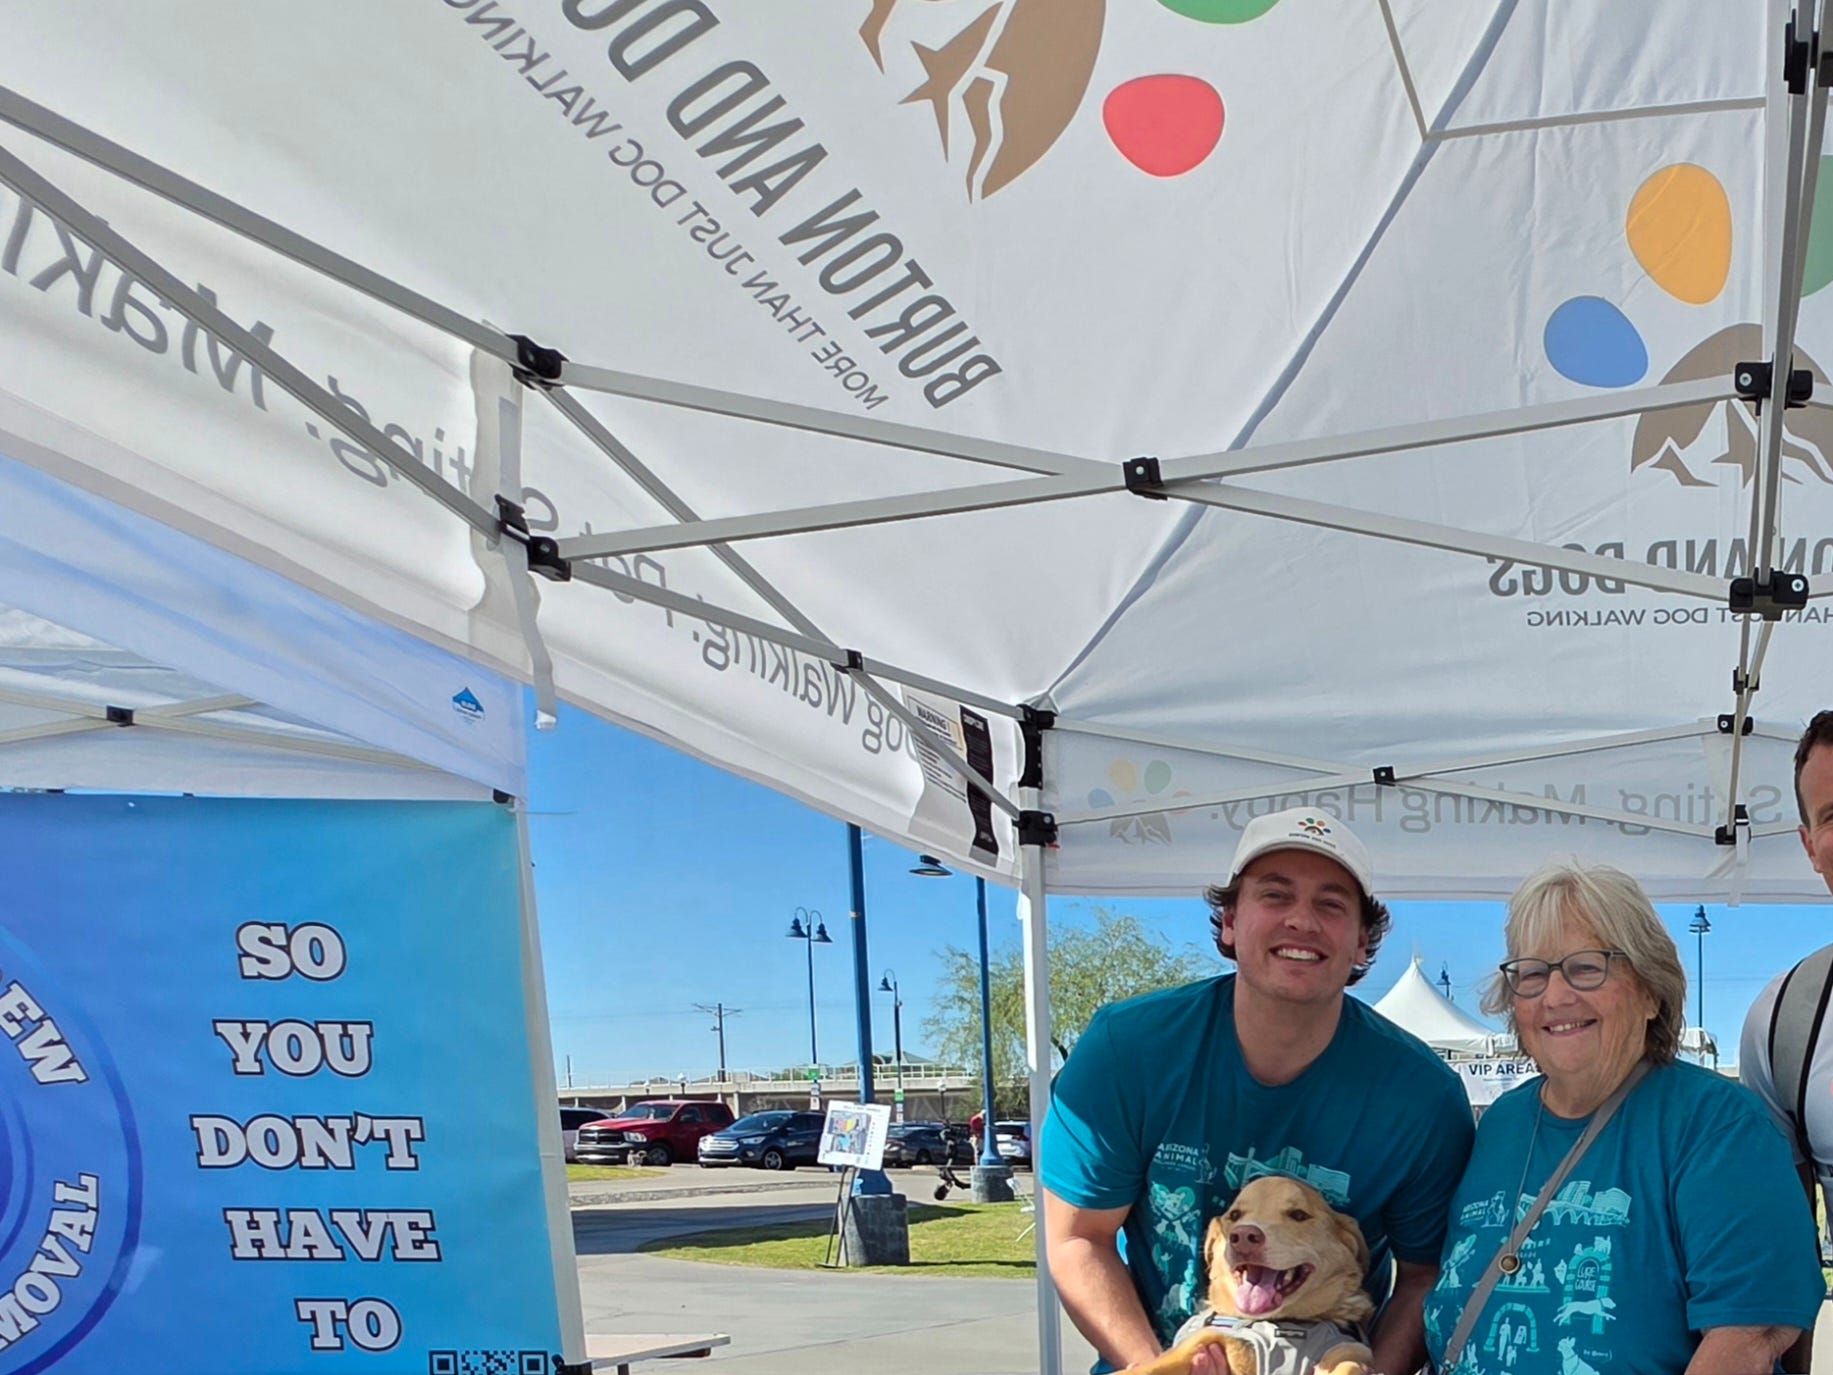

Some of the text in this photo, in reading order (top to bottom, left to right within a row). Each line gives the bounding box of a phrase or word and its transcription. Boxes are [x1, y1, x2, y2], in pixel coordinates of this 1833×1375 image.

[236, 921, 346, 980] SO
[0, 980, 89, 1086] EW
[213, 1018, 374, 1077] YOU
[1468, 1063, 1535, 1075] VIP AREA
[1154, 1152, 1198, 1166] ANIMAL
[0, 1172, 99, 1352] MOVAL
[223, 1207, 442, 1262] HAVE
[294, 1297, 402, 1351] TO
